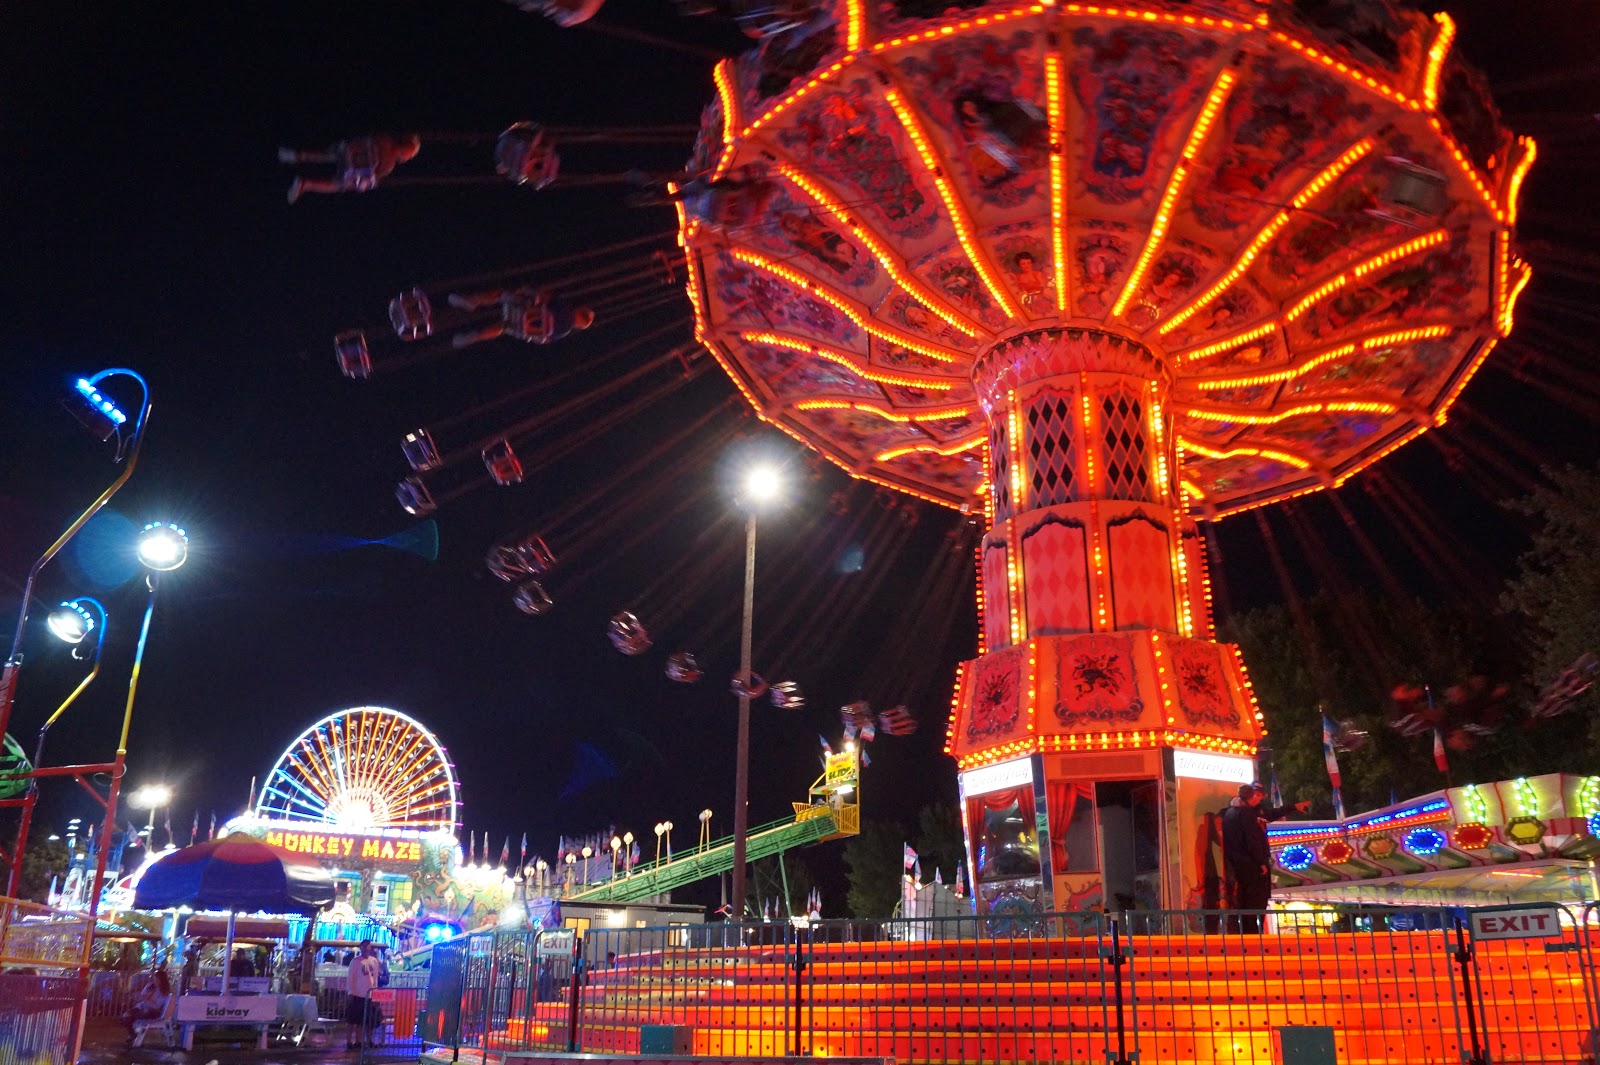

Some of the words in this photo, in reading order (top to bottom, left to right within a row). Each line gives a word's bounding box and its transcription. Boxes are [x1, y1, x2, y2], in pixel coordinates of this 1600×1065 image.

[266, 831, 354, 856] MONKEY
[361, 839, 421, 861] MAZE
[1478, 914, 1550, 933] EXIT
[543, 937, 571, 949] EXIT
[207, 1007, 250, 1017] kidway
